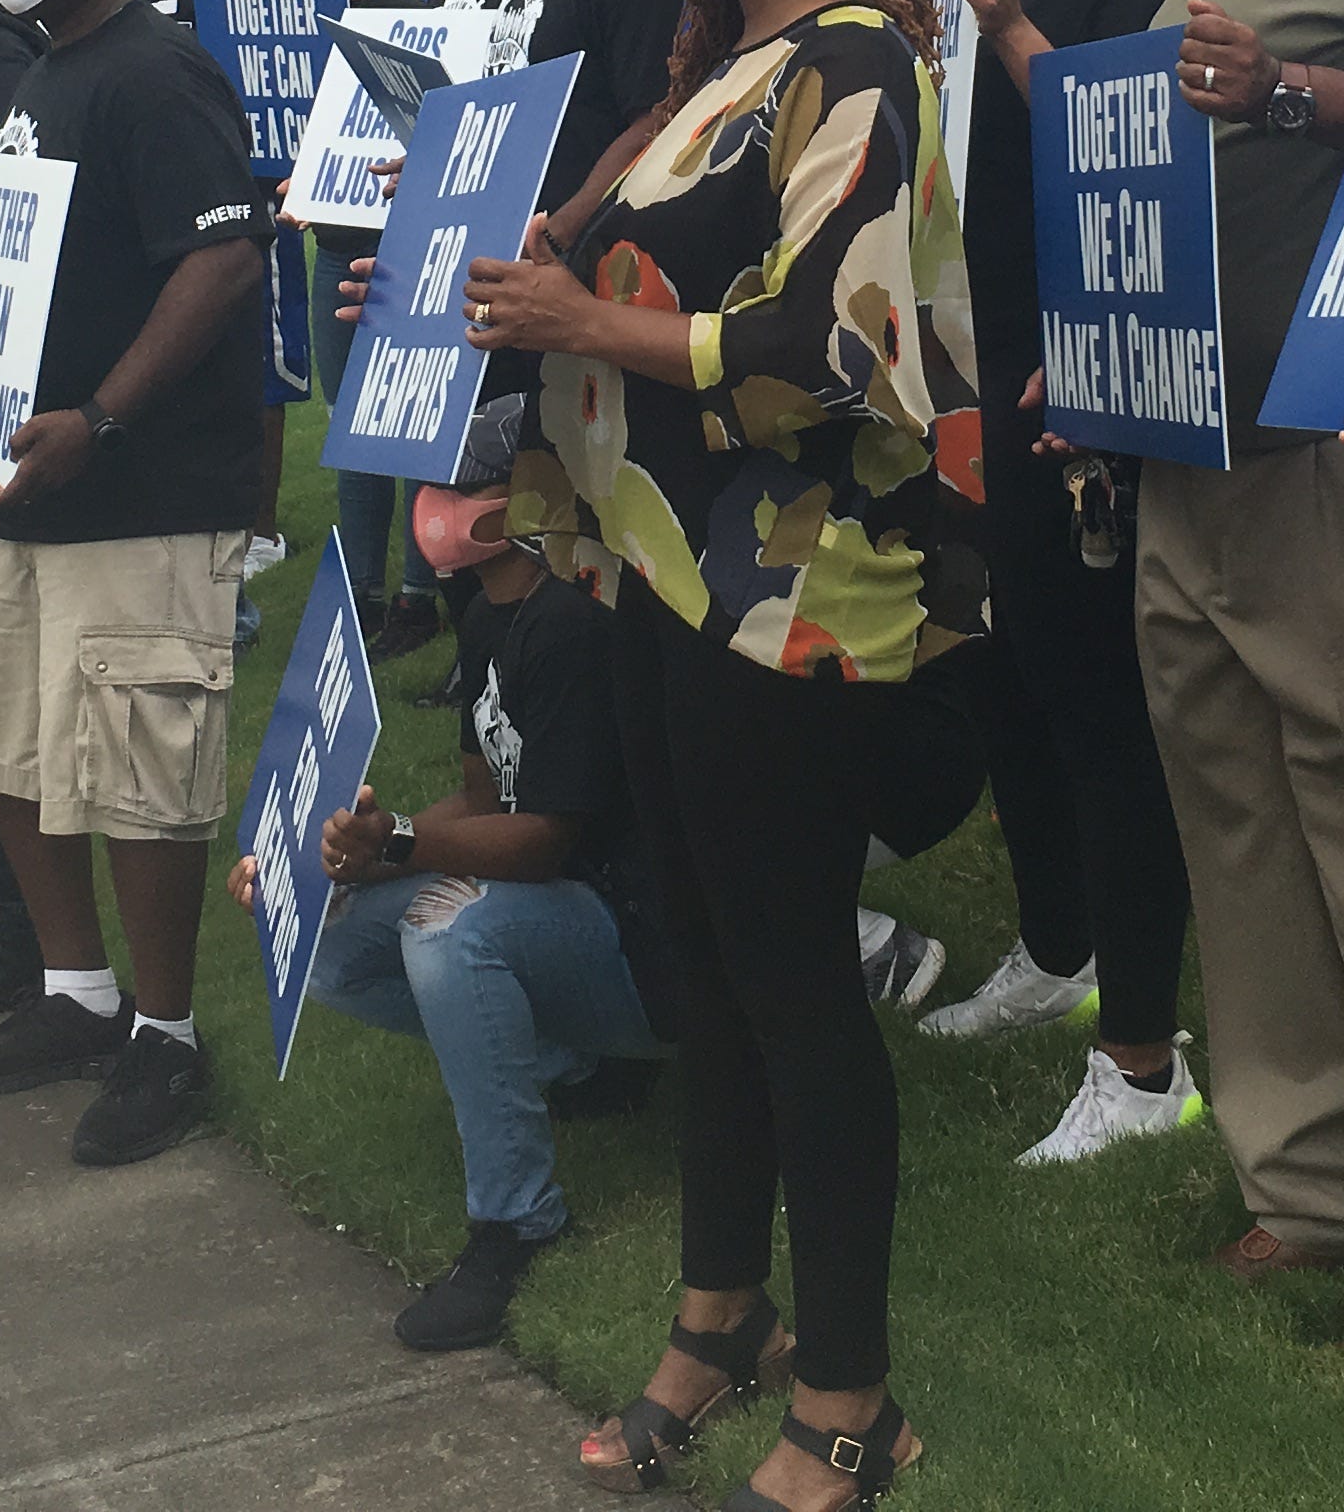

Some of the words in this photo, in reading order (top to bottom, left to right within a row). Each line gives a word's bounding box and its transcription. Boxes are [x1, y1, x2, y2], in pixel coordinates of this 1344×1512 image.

[237, 44, 273, 98] WE
[273, 43, 315, 99] CAN
[1062, 70, 1173, 173] TOGETHER
[310, 146, 394, 208] INJUS
[437, 100, 517, 199] PRAY
[410, 224, 468, 317] FOR
[1076, 191, 1115, 292] WE
[1118, 187, 1164, 294] CAN
[349, 335, 461, 443] MEMPHIS
[1042, 309, 1105, 414] MAKE
[1108, 312, 1125, 416] A
[1126, 311, 1221, 429] CHANGE
[314, 606, 354, 754] PRAY
[288, 725, 321, 852] FOR
